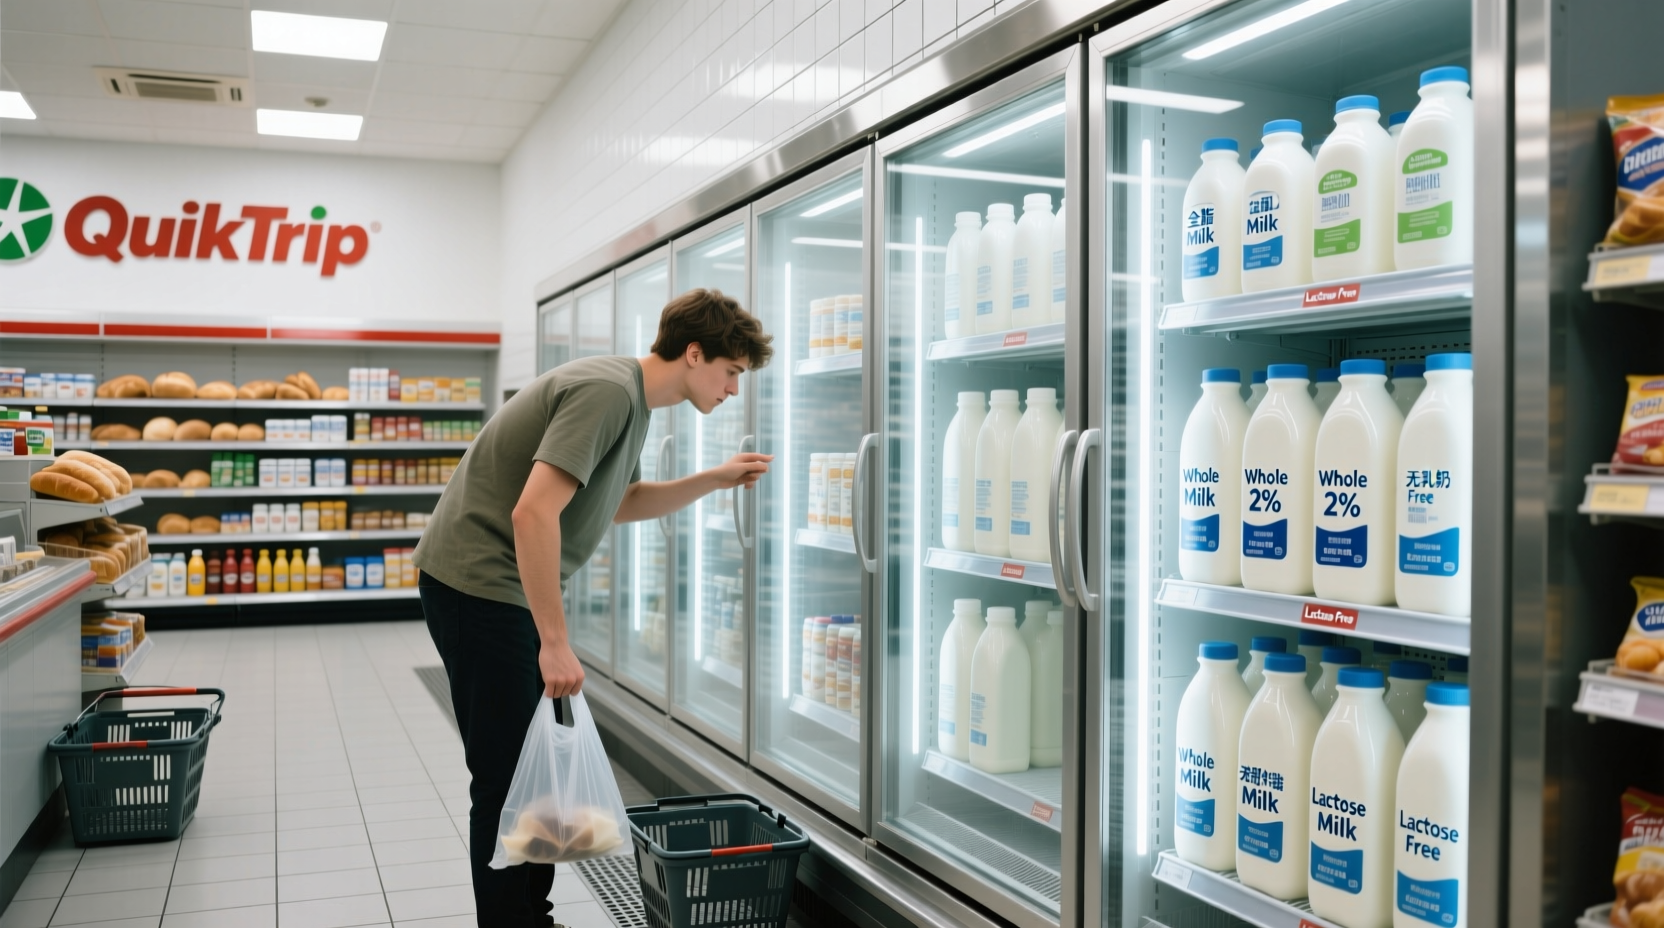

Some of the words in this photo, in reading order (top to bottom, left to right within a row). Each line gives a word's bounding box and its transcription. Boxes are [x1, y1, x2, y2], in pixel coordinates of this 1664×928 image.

[64, 195, 369, 277] QuikTrip
[1187, 226, 1215, 246] Milk
[1246, 213, 1279, 235] Milk
[1183, 467, 1219, 484] Whole
[1245, 469, 1288, 485] Whole
[1319, 470, 1368, 488] Whole
[1184, 487, 1216, 507] Milk
[1249, 488, 1281, 513] 2%
[1323, 491, 1361, 518] 2%
[1407, 489, 1434, 505] Free
[1178, 747, 1215, 769] Whole
[1180, 768, 1211, 792] Milk
[1242, 786, 1279, 814] Milk
[1312, 787, 1367, 817] Lactose
[1317, 812, 1357, 842] Milk
[1400, 810, 1459, 843] Lactose
[1405, 834, 1441, 861] Free
